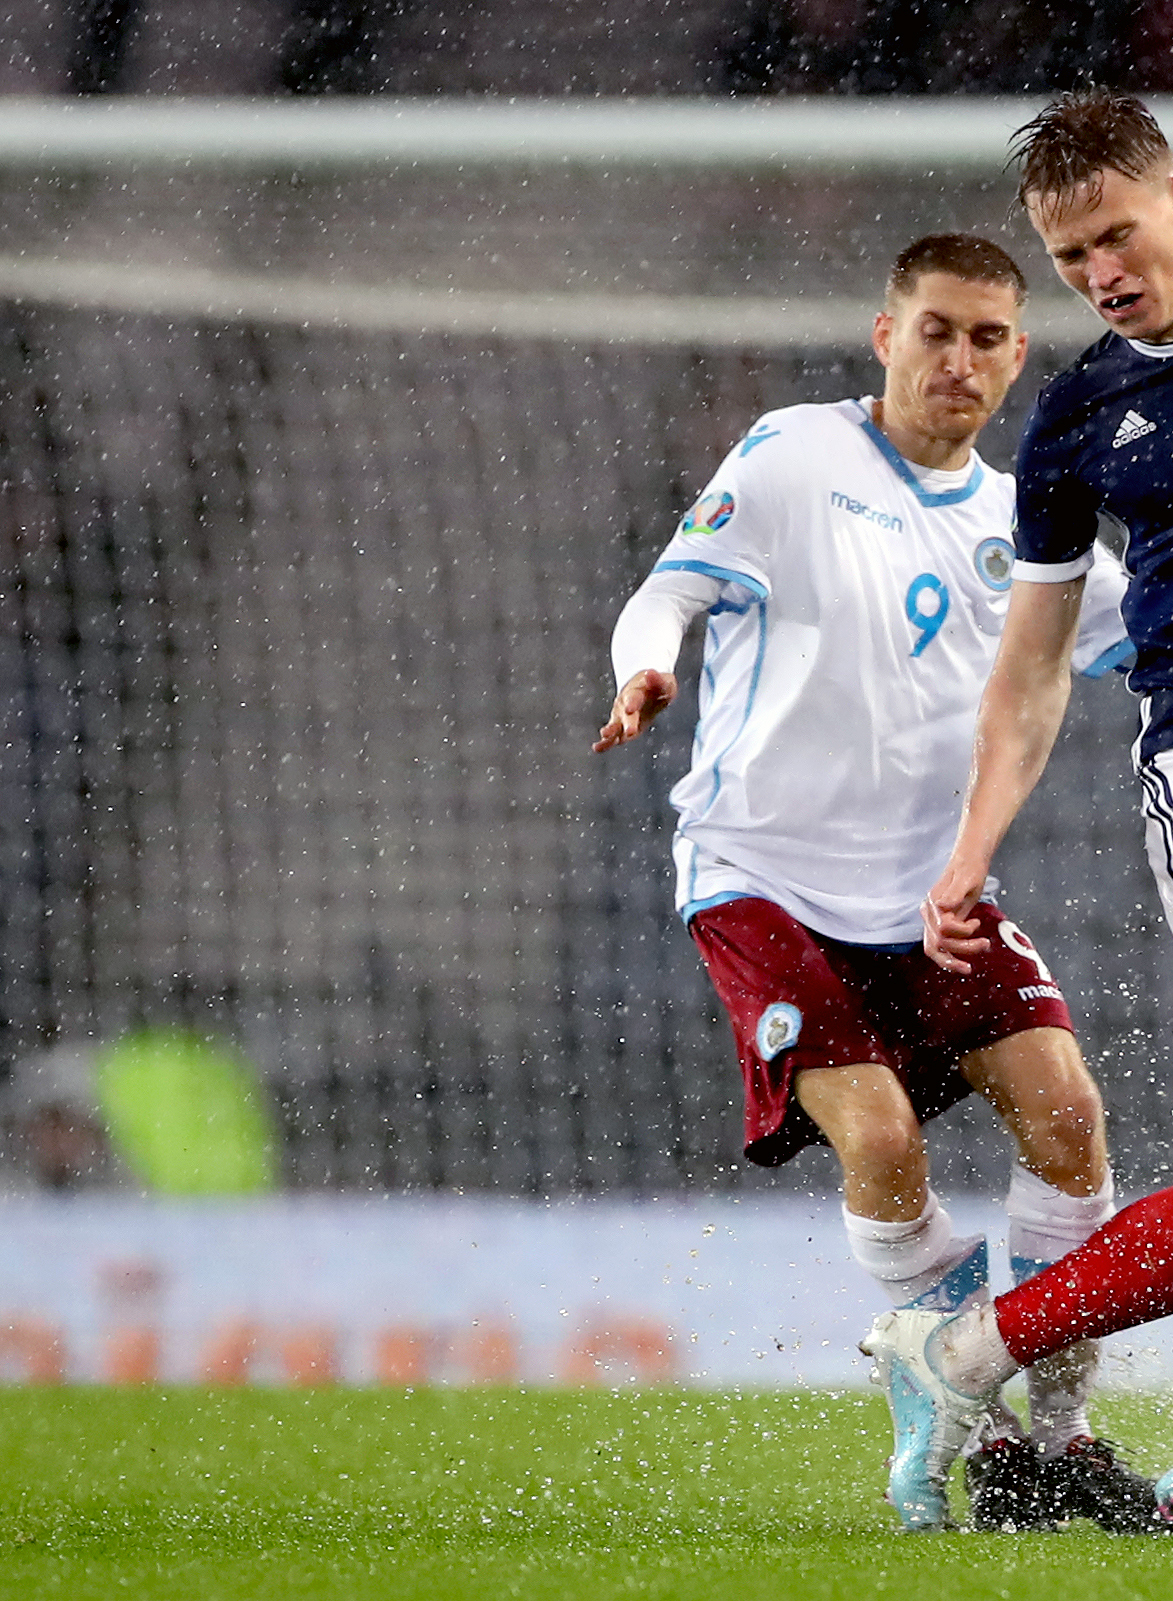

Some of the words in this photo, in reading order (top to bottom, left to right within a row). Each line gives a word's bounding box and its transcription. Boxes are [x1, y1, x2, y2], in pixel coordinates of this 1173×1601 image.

[1111, 421, 1157, 450] adidas
[831, 491, 904, 533] macron
[905, 572, 950, 658] 9
[997, 920, 1053, 982] 9
[1017, 984, 1065, 1002] mac
